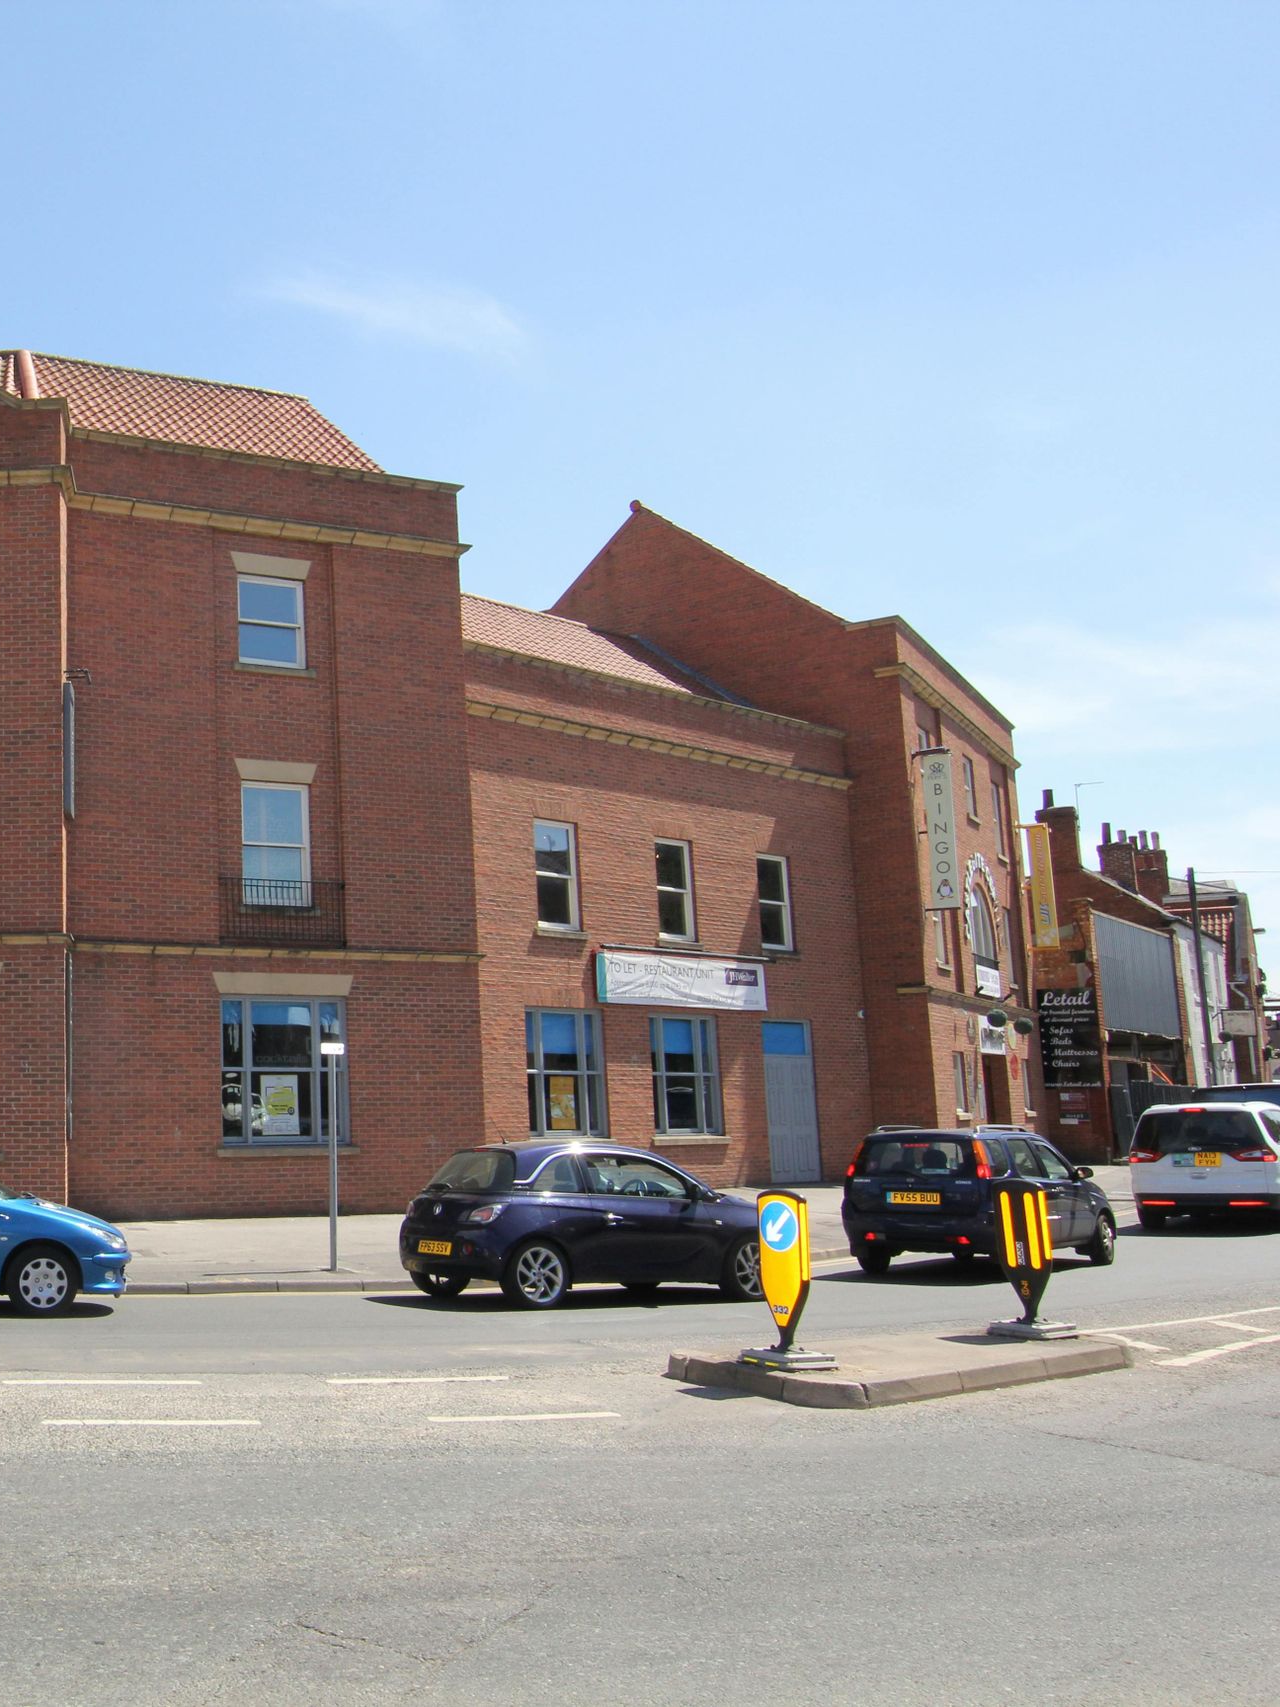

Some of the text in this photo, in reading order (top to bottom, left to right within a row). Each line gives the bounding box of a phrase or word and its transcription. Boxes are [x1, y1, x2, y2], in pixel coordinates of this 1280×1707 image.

[933, 782, 951, 874] BINGO
[609, 961, 621, 973] TO
[623, 963, 637, 974] LET
[644, 964, 694, 977] RESTAURANT
[696, 968, 714, 979] UNIT
[1040, 990, 1091, 1006] Letail
[1048, 1026, 1073, 1035] Sofas
[1050, 1037, 1072, 1045] Beds
[1051, 1048, 1098, 1056] Mattresses
[1052, 1059, 1080, 1067] Chairs
[893, 1192, 918, 1202] FV55
[773, 1304, 790, 1315] 332
